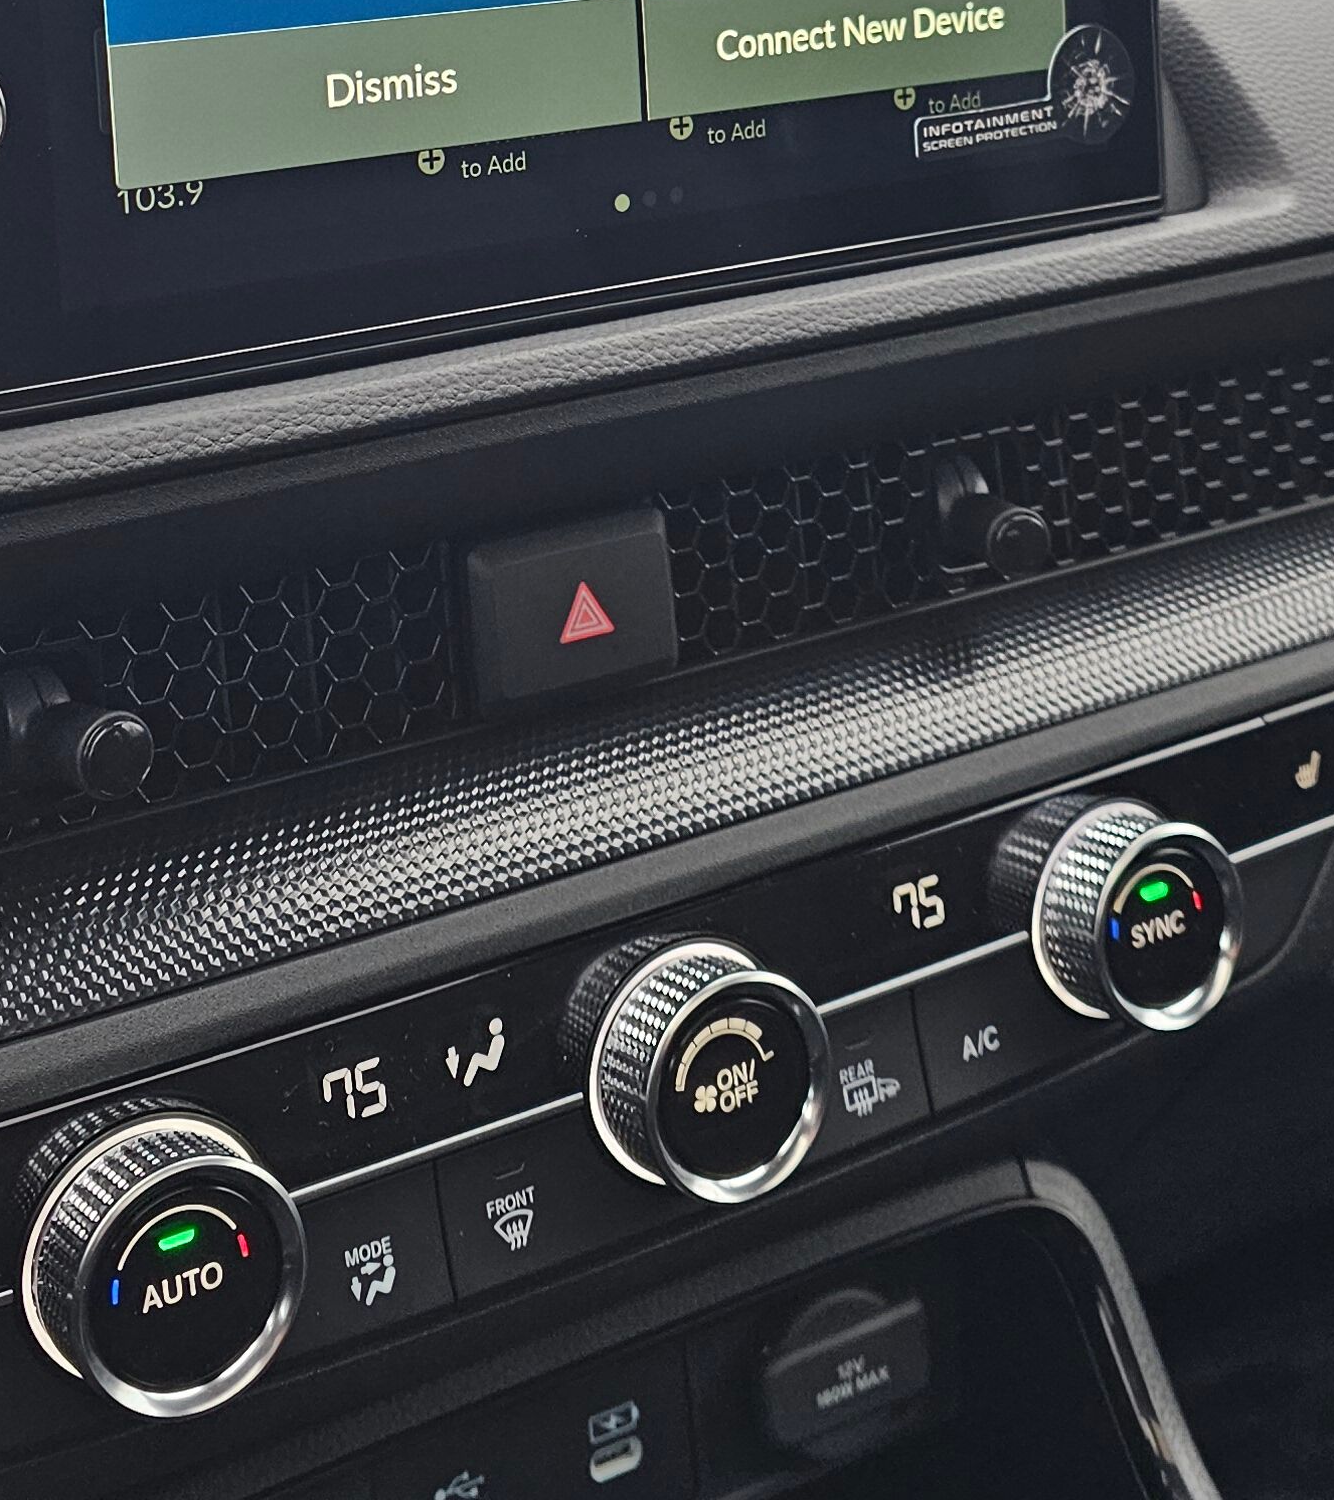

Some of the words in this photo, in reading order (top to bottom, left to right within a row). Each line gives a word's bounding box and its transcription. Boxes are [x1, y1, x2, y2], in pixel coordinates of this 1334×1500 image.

[715, 19, 836, 61] Connect
[842, 15, 907, 47] New
[914, 1, 1005, 39] Device
[326, 63, 458, 108] Dismiss
[929, 98, 945, 114] to
[949, 90, 981, 112] Add
[707, 124, 727, 144] to
[731, 119, 766, 141] Add
[922, 134, 974, 153] SCREEN
[976, 120, 1057, 144] PROTECTION
[923, 105, 1054, 138] INFOTAINMENT
[461, 159, 482, 179] to
[487, 151, 526, 176] Add
[117, 181, 203, 214] 103.9
[893, 874, 945, 930] 75
[1130, 908, 1186, 949] SYNC
[962, 1025, 1000, 1062] A/C
[322, 1056, 387, 1119] 75
[717, 1058, 756, 1091] ON/
[839, 1059, 874, 1085] REAR
[719, 1079, 759, 1113] OFF
[486, 1185, 535, 1219] FRONT
[344, 1236, 392, 1268] MODE
[141, 1260, 223, 1314] AUTO
